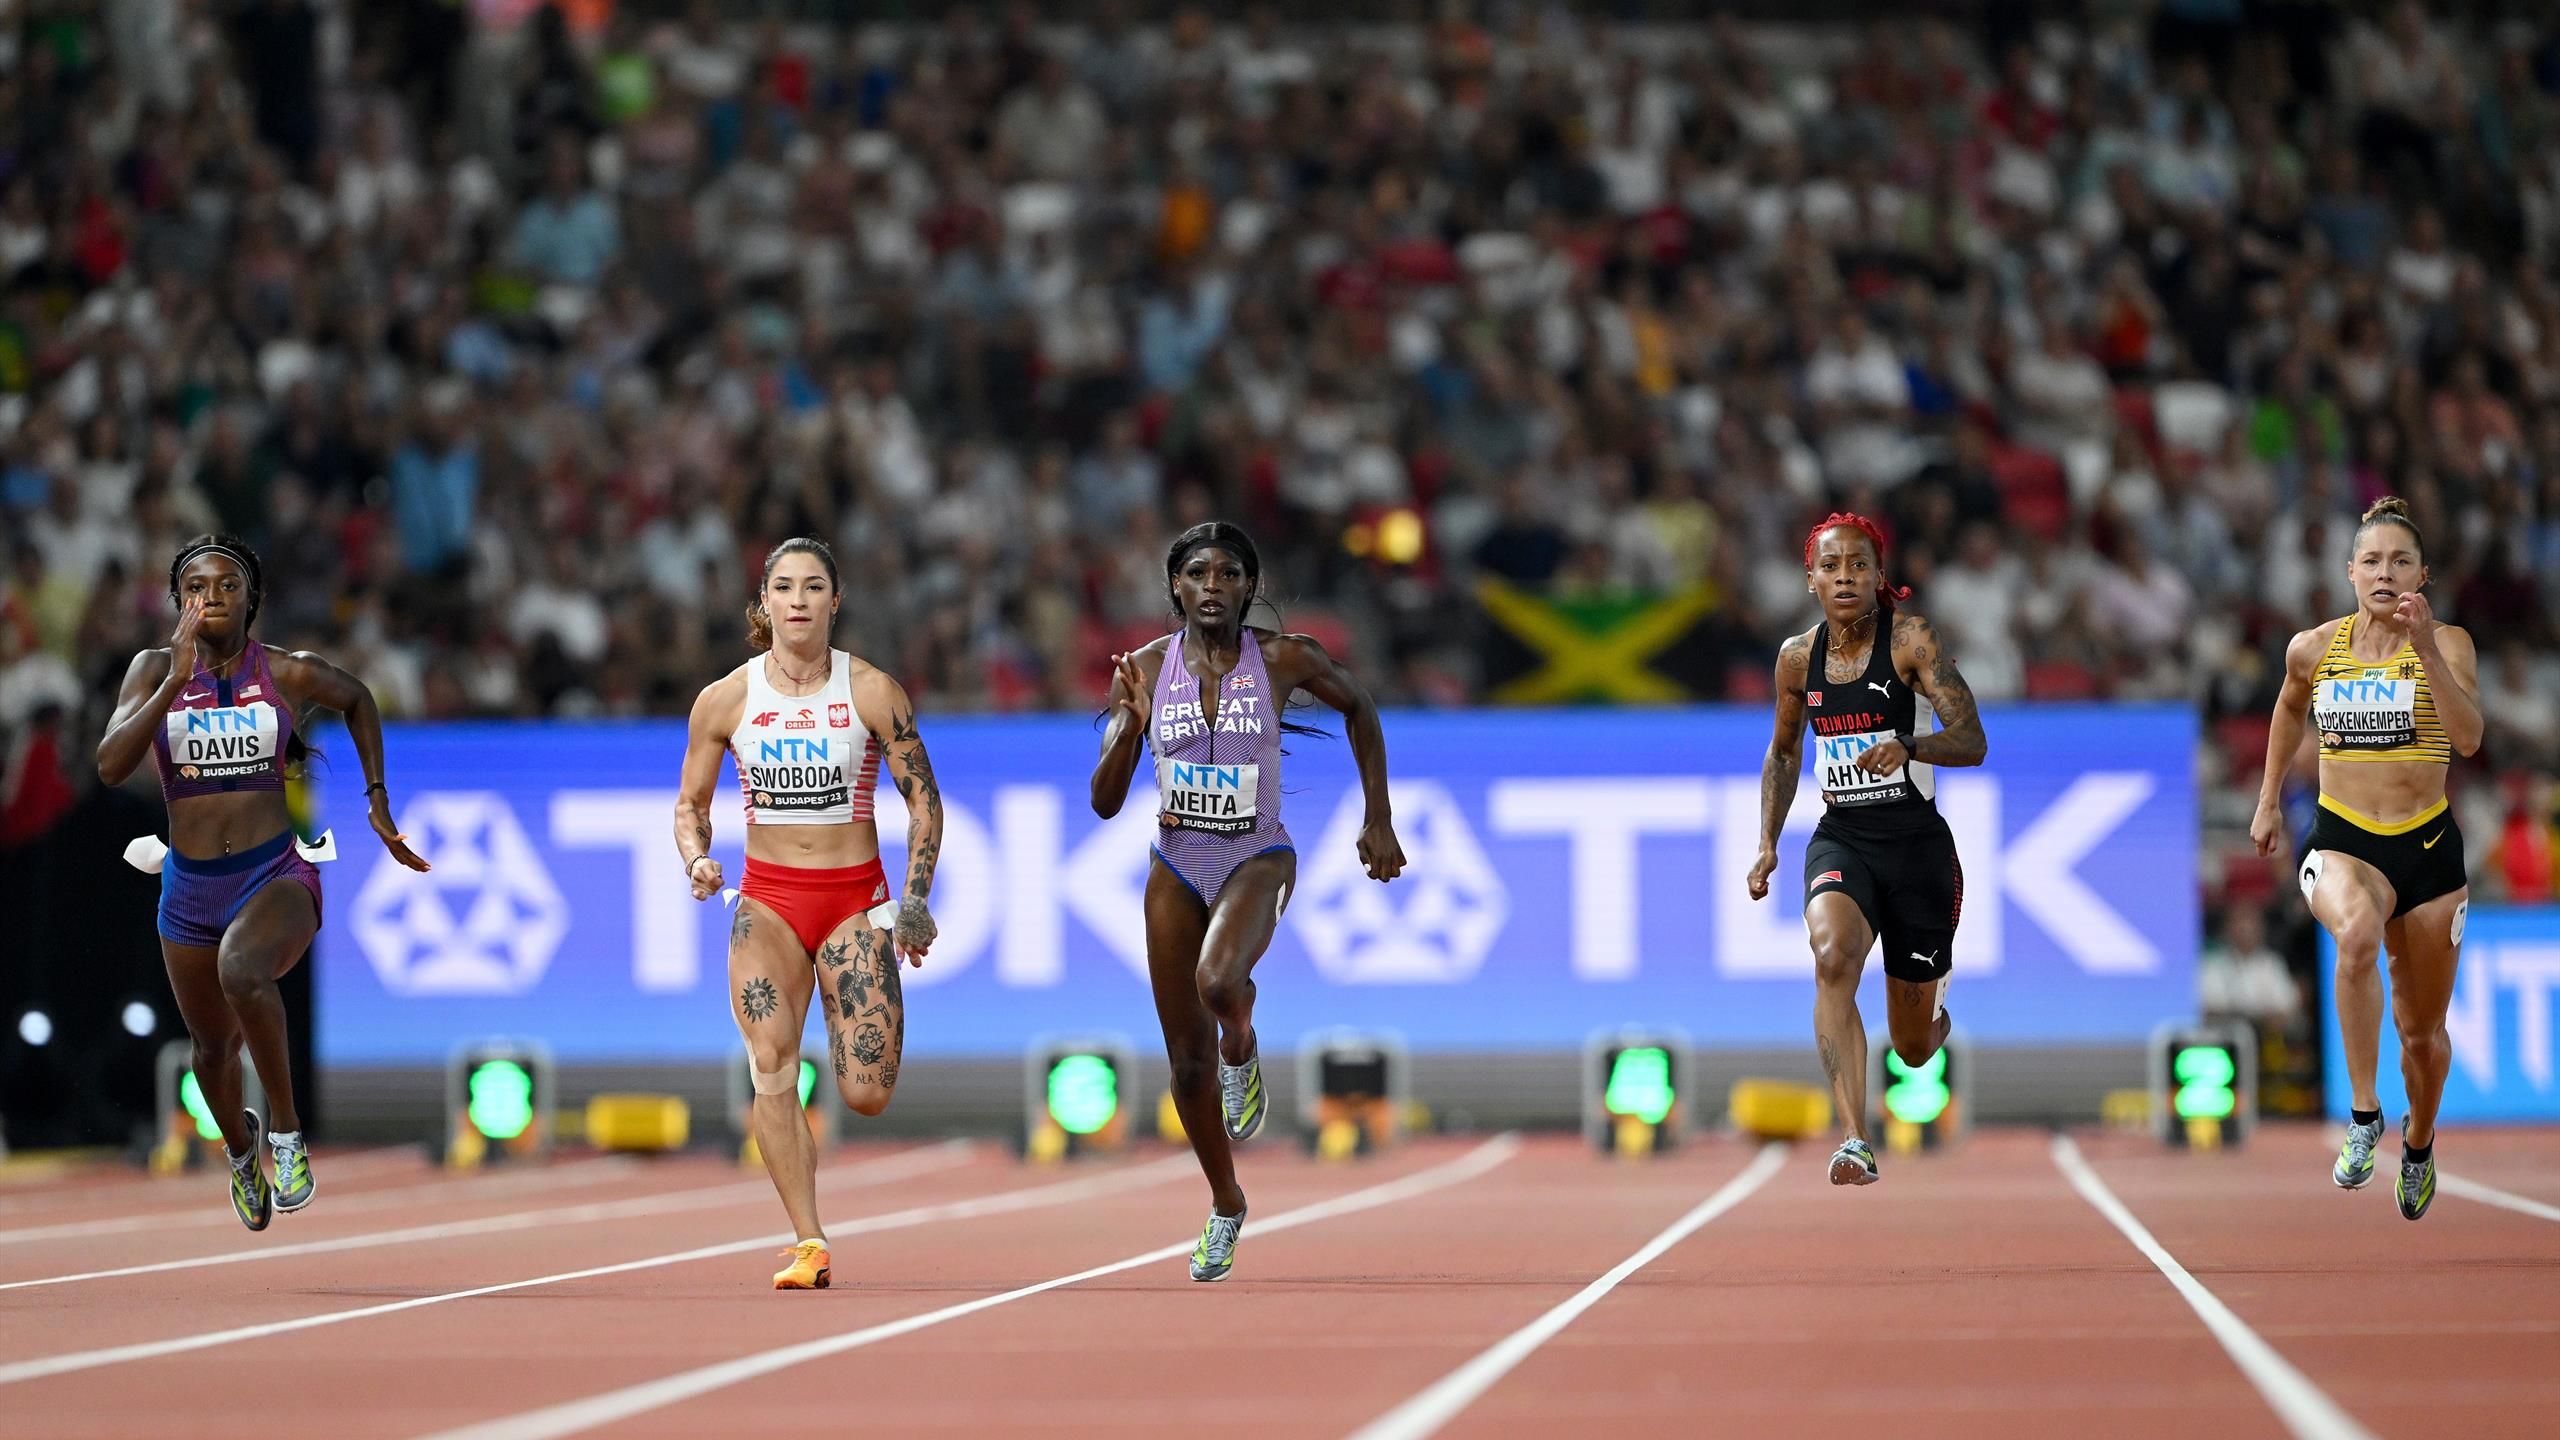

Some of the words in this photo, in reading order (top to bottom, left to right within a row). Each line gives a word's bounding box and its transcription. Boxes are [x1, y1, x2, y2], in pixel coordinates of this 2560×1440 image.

[2333, 680, 2397, 703] NTN
[752, 711, 779, 727] 4F
[1161, 697, 1258, 721] GREAT
[2318, 708, 2411, 730] LÜCKENKEMPER
[187, 708, 257, 735] NTN
[786, 720, 815, 729] ORLEN
[1160, 717, 1261, 742] BRITAIN
[1815, 712, 1872, 733] TRINIDAD
[188, 735, 260, 761] DAVIS
[2345, 735, 2396, 744] BUDAPEST
[2398, 733, 2411, 742] 23
[760, 738, 828, 763] NTN
[203, 766, 257, 777] BUDAPEST
[258, 762, 269, 771] 23
[751, 766, 843, 789] SWOBODA
[1173, 762, 1239, 790] NTN
[775, 796, 829, 805] BUDAPEST
[830, 792, 841, 801] 23
[1171, 789, 1237, 816] NEITA
[1837, 790, 1888, 803] BUDAPEST
[1888, 787, 1901, 797] 23
[1183, 819, 1237, 831] BUDAPEST
[1238, 821, 1250, 829] 23
